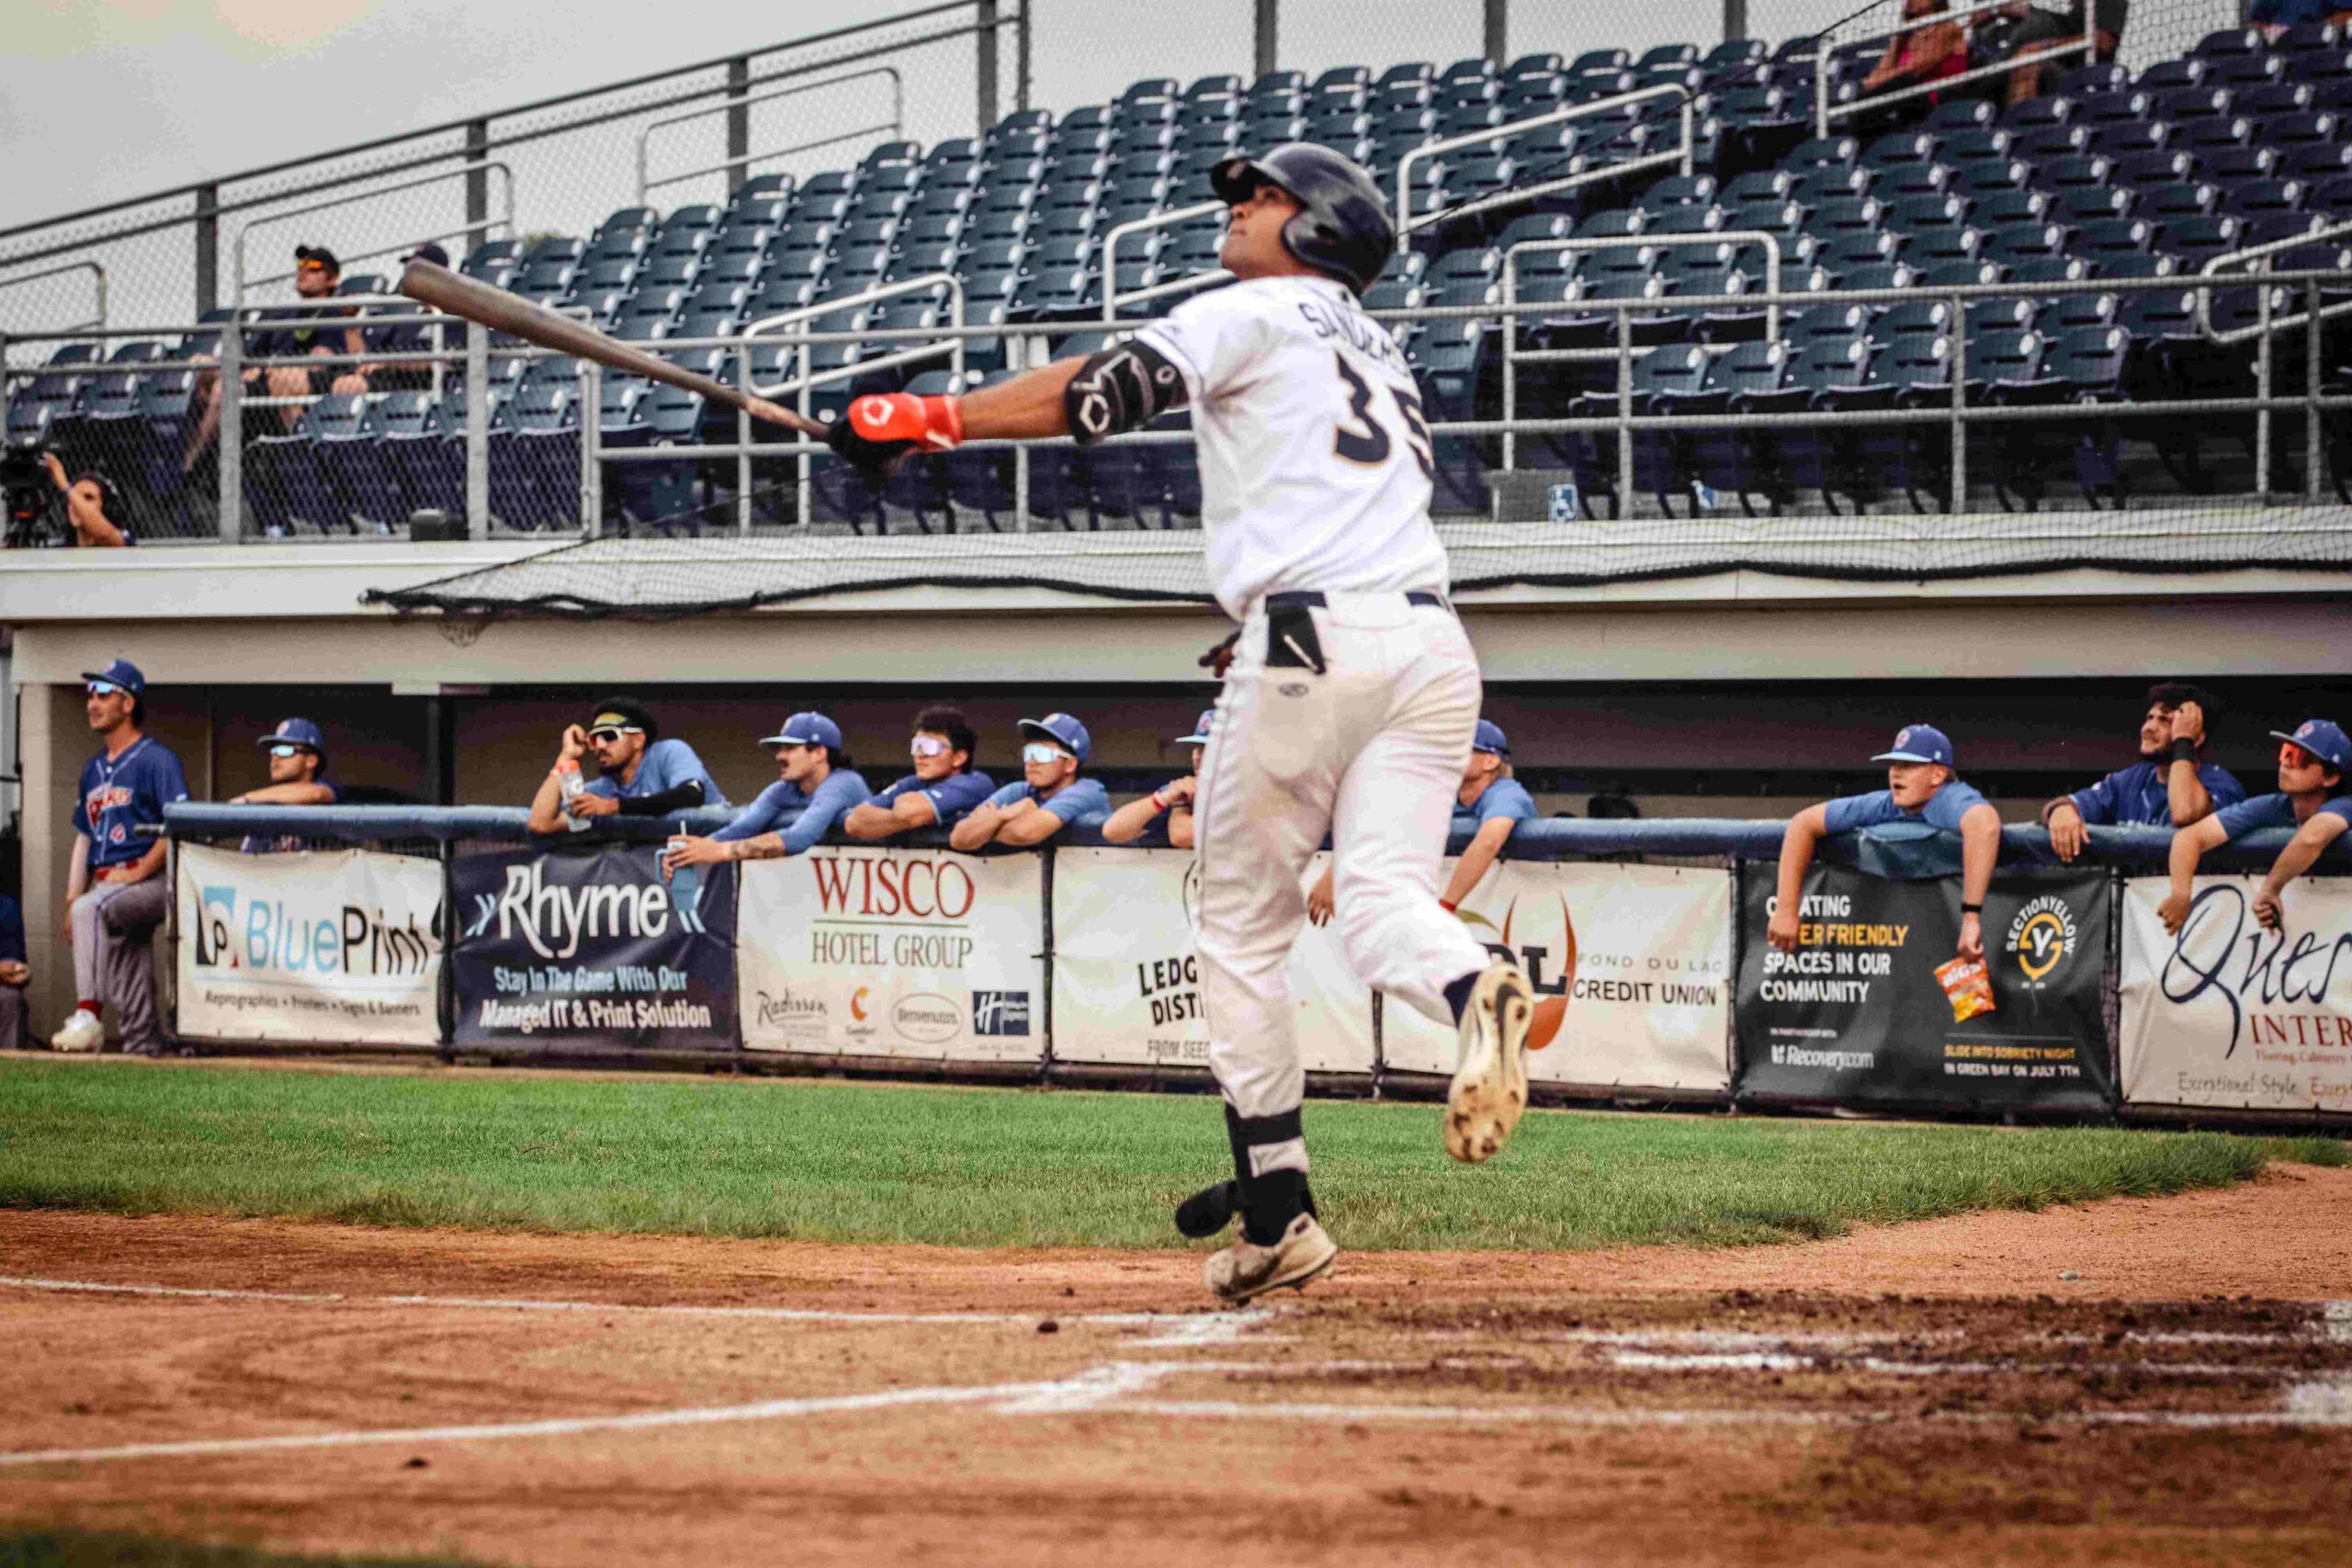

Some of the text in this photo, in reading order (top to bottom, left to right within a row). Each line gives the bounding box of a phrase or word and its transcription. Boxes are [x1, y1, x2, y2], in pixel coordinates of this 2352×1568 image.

[809, 855, 975, 919] WISCO
[499, 861, 669, 959] Rhyme
[1765, 894, 1851, 918] CATING
[246, 899, 428, 975] BluePrint
[811, 931, 974, 969] HOTEL GROUP
[1826, 923, 1909, 947] FRIENDLY
[1138, 955, 1198, 997] LEDG
[1577, 953, 1723, 974] FOND DU LAC
[1762, 951, 1892, 976] SPACES IN OUR
[493, 965, 688, 998] Stay In The Game With Our
[1573, 978, 1718, 1007] CREDIT UNION
[1759, 979, 1870, 1003] COMMUNITY
[479, 999, 712, 1034] Managed IT & Print Solution
[2250, 1014, 2352, 1046] INTER
[2030, 1065, 2056, 1077] JULY
